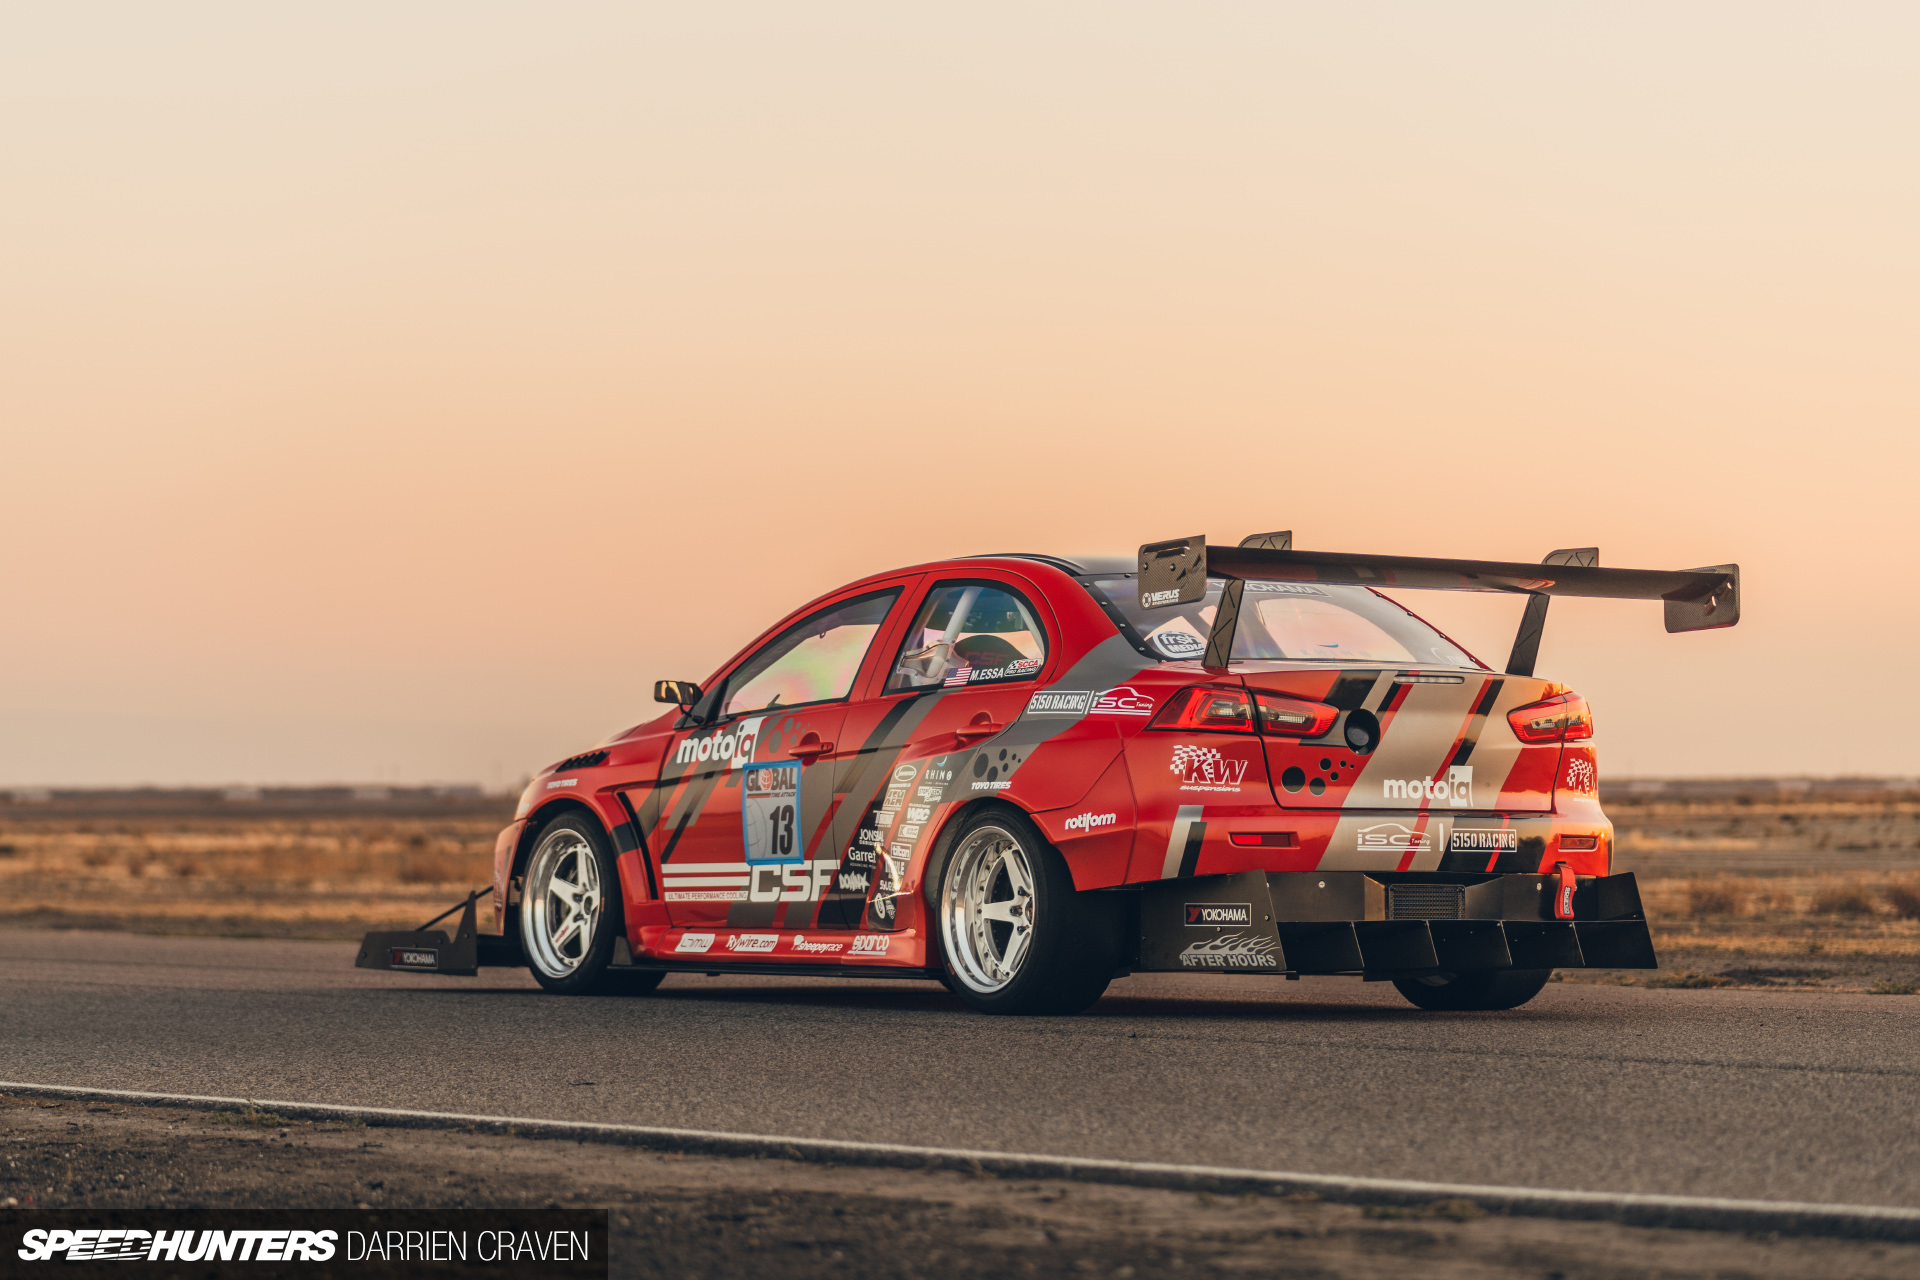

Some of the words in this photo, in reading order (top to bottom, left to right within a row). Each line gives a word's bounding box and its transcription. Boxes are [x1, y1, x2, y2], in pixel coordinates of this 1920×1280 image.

[1151, 589, 1180, 601] VERUS
[1017, 660, 1039, 669] SCCA
[969, 667, 1004, 681] M.ESSA
[1031, 694, 1051, 709] 5150
[1051, 694, 1085, 709] RACING
[1183, 758, 1248, 785] KW
[971, 782, 989, 790] TOYO
[989, 781, 1012, 790] TIRES
[1065, 812, 1117, 832] rotiform
[769, 804, 795, 856] 13
[1453, 832, 1478, 848] 5150
[1479, 831, 1515, 848] RACING
[750, 859, 840, 902] CSF
[668, 892, 691, 900] ULTIMATE
[691, 892, 726, 900] PERFORMANCE
[726, 891, 747, 899] COOLING
[1202, 908, 1248, 922] YOKOHAMA
[726, 935, 776, 951] Rywire.com
[799, 940, 844, 953] sheepeyrace
[851, 935, 890, 954] sparco
[403, 952, 436, 965] YOKOHAMA
[1182, 954, 1225, 967] AFTER
[1229, 954, 1278, 967] HOURS
